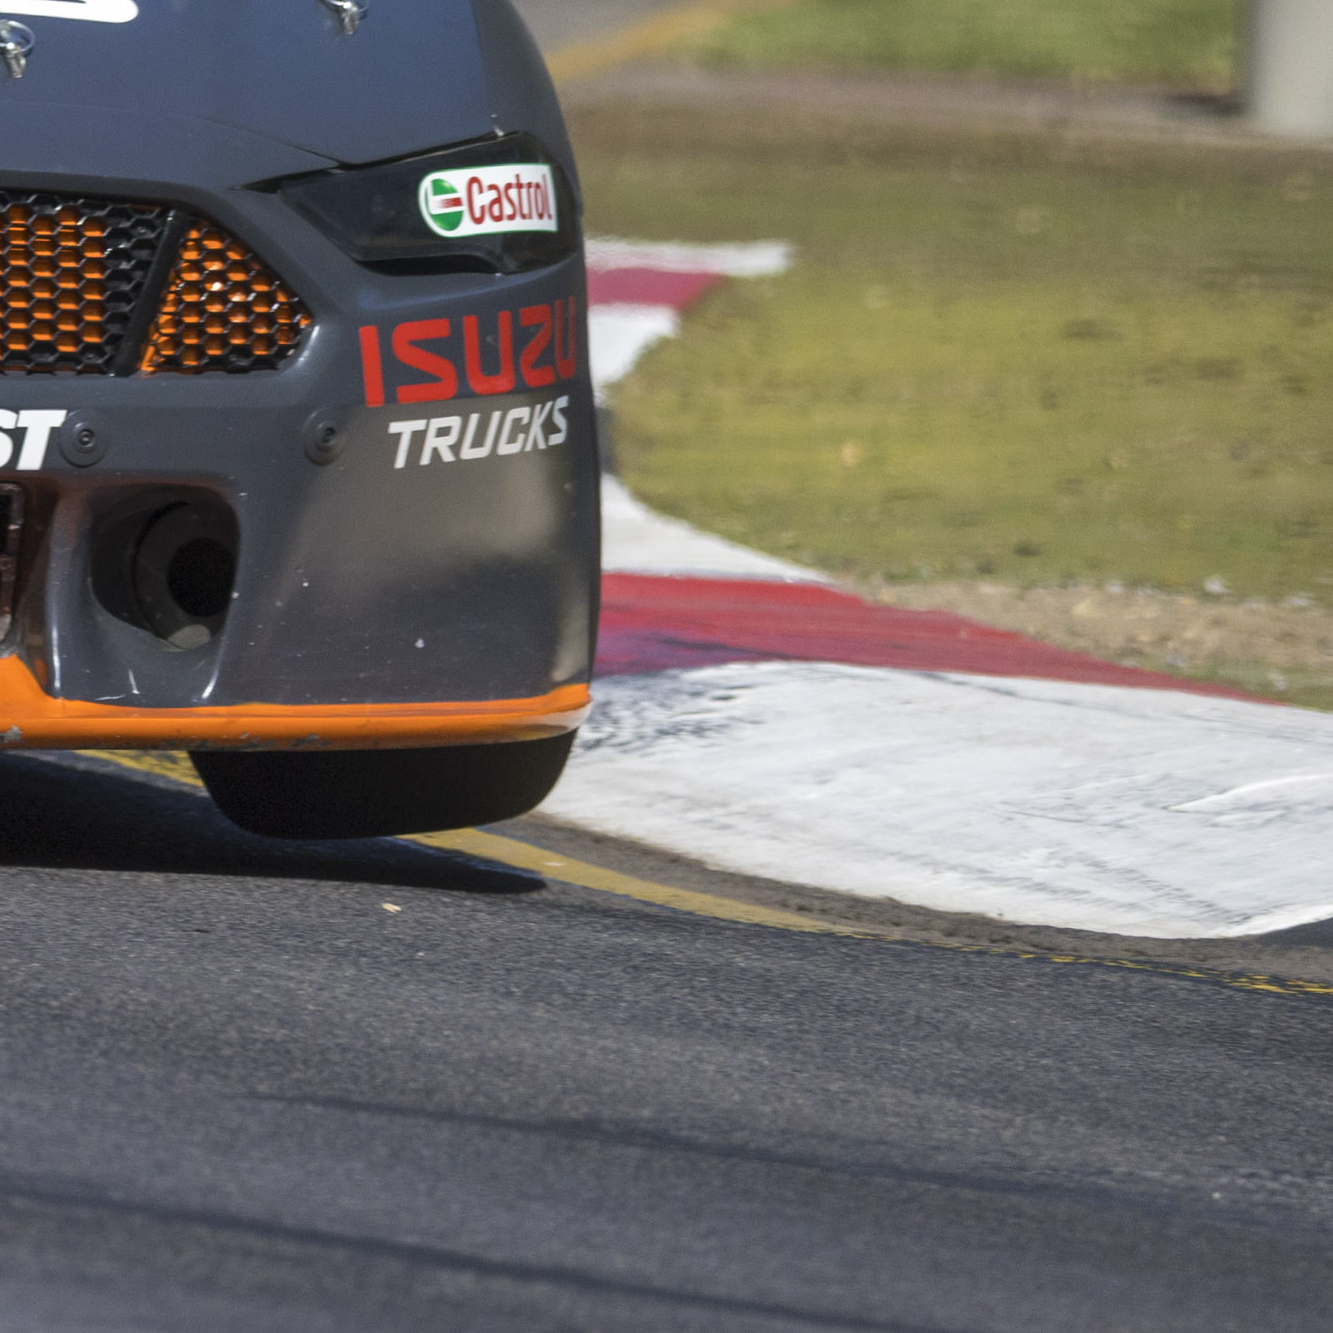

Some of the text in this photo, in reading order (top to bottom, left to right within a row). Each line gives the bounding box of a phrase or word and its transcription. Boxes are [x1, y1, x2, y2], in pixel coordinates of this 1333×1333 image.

[466, 173, 553, 225] Castrol
[358, 295, 577, 408] ISUZU
[388, 395, 570, 469] TRUCKS
